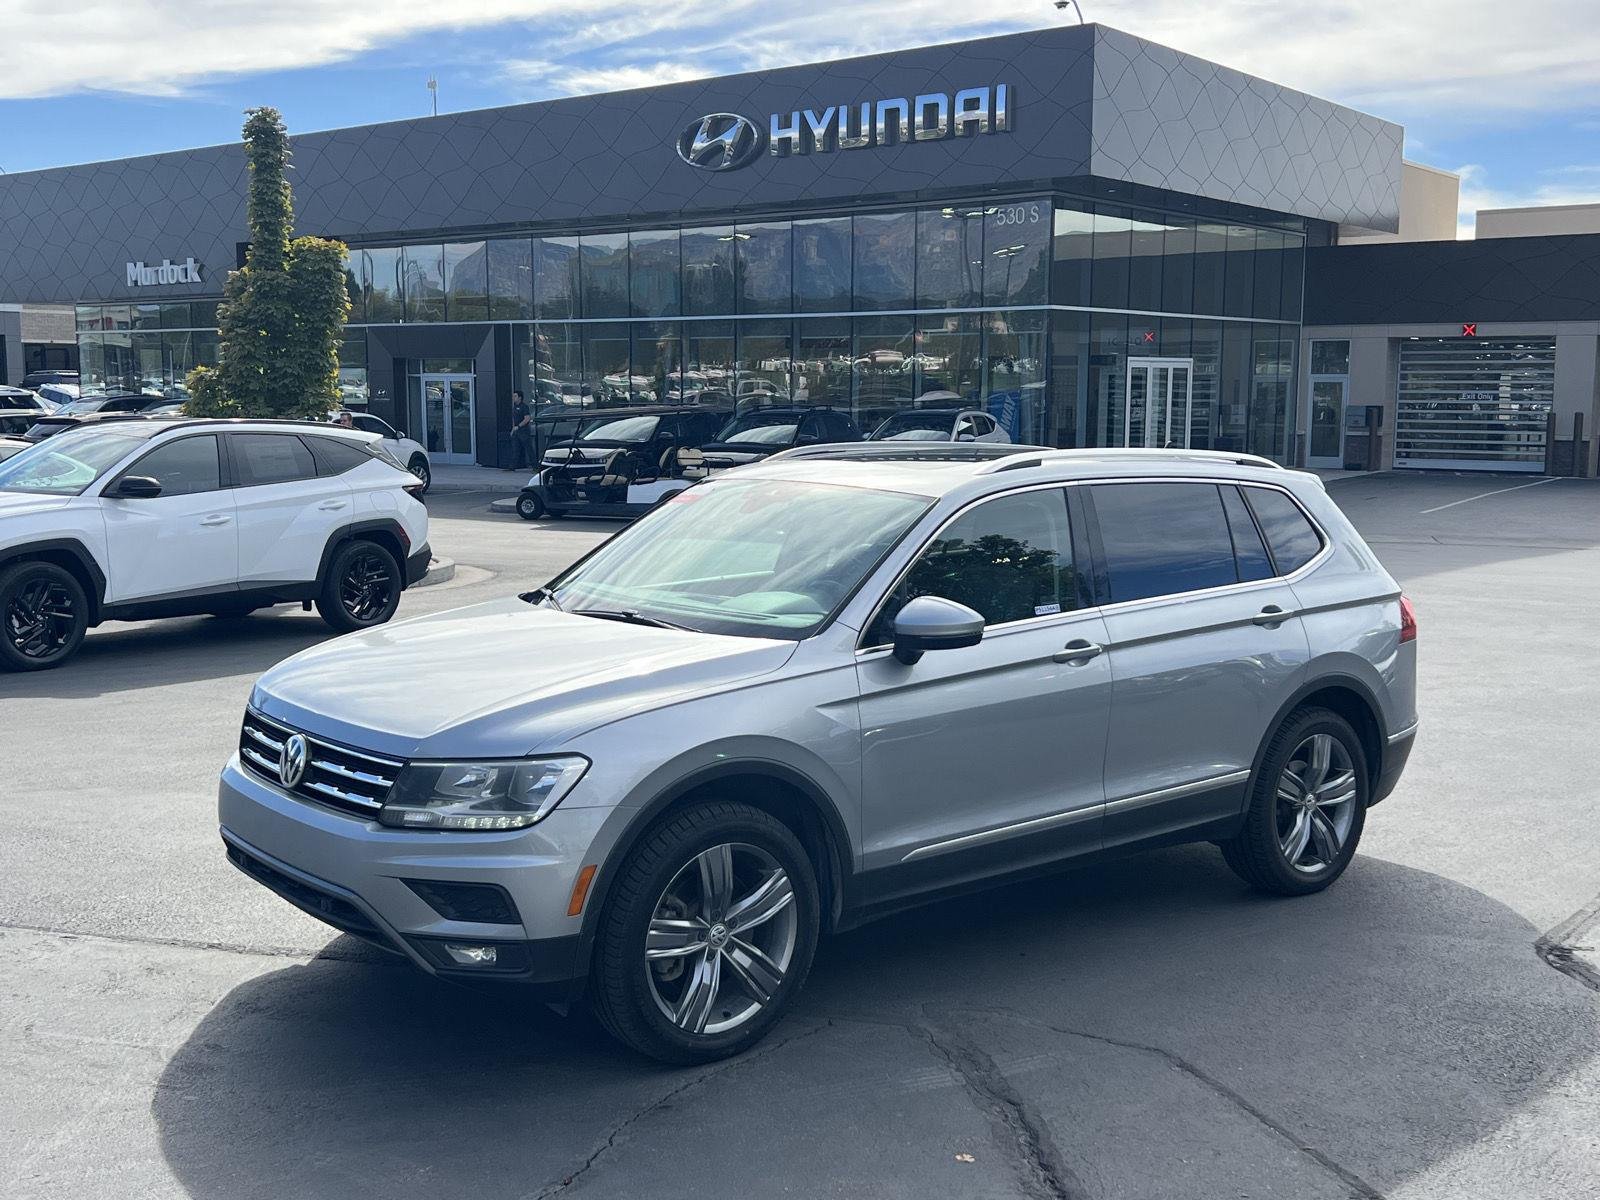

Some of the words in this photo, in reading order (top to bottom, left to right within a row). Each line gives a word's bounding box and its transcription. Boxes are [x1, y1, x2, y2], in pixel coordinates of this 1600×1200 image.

[770, 83, 1012, 157] HYUNDAI
[996, 207, 1026, 225] 530
[1030, 205, 1039, 223] S
[126, 257, 202, 287] Murdock
[1461, 392, 1476, 400] Exit
[1477, 391, 1493, 401] Only
